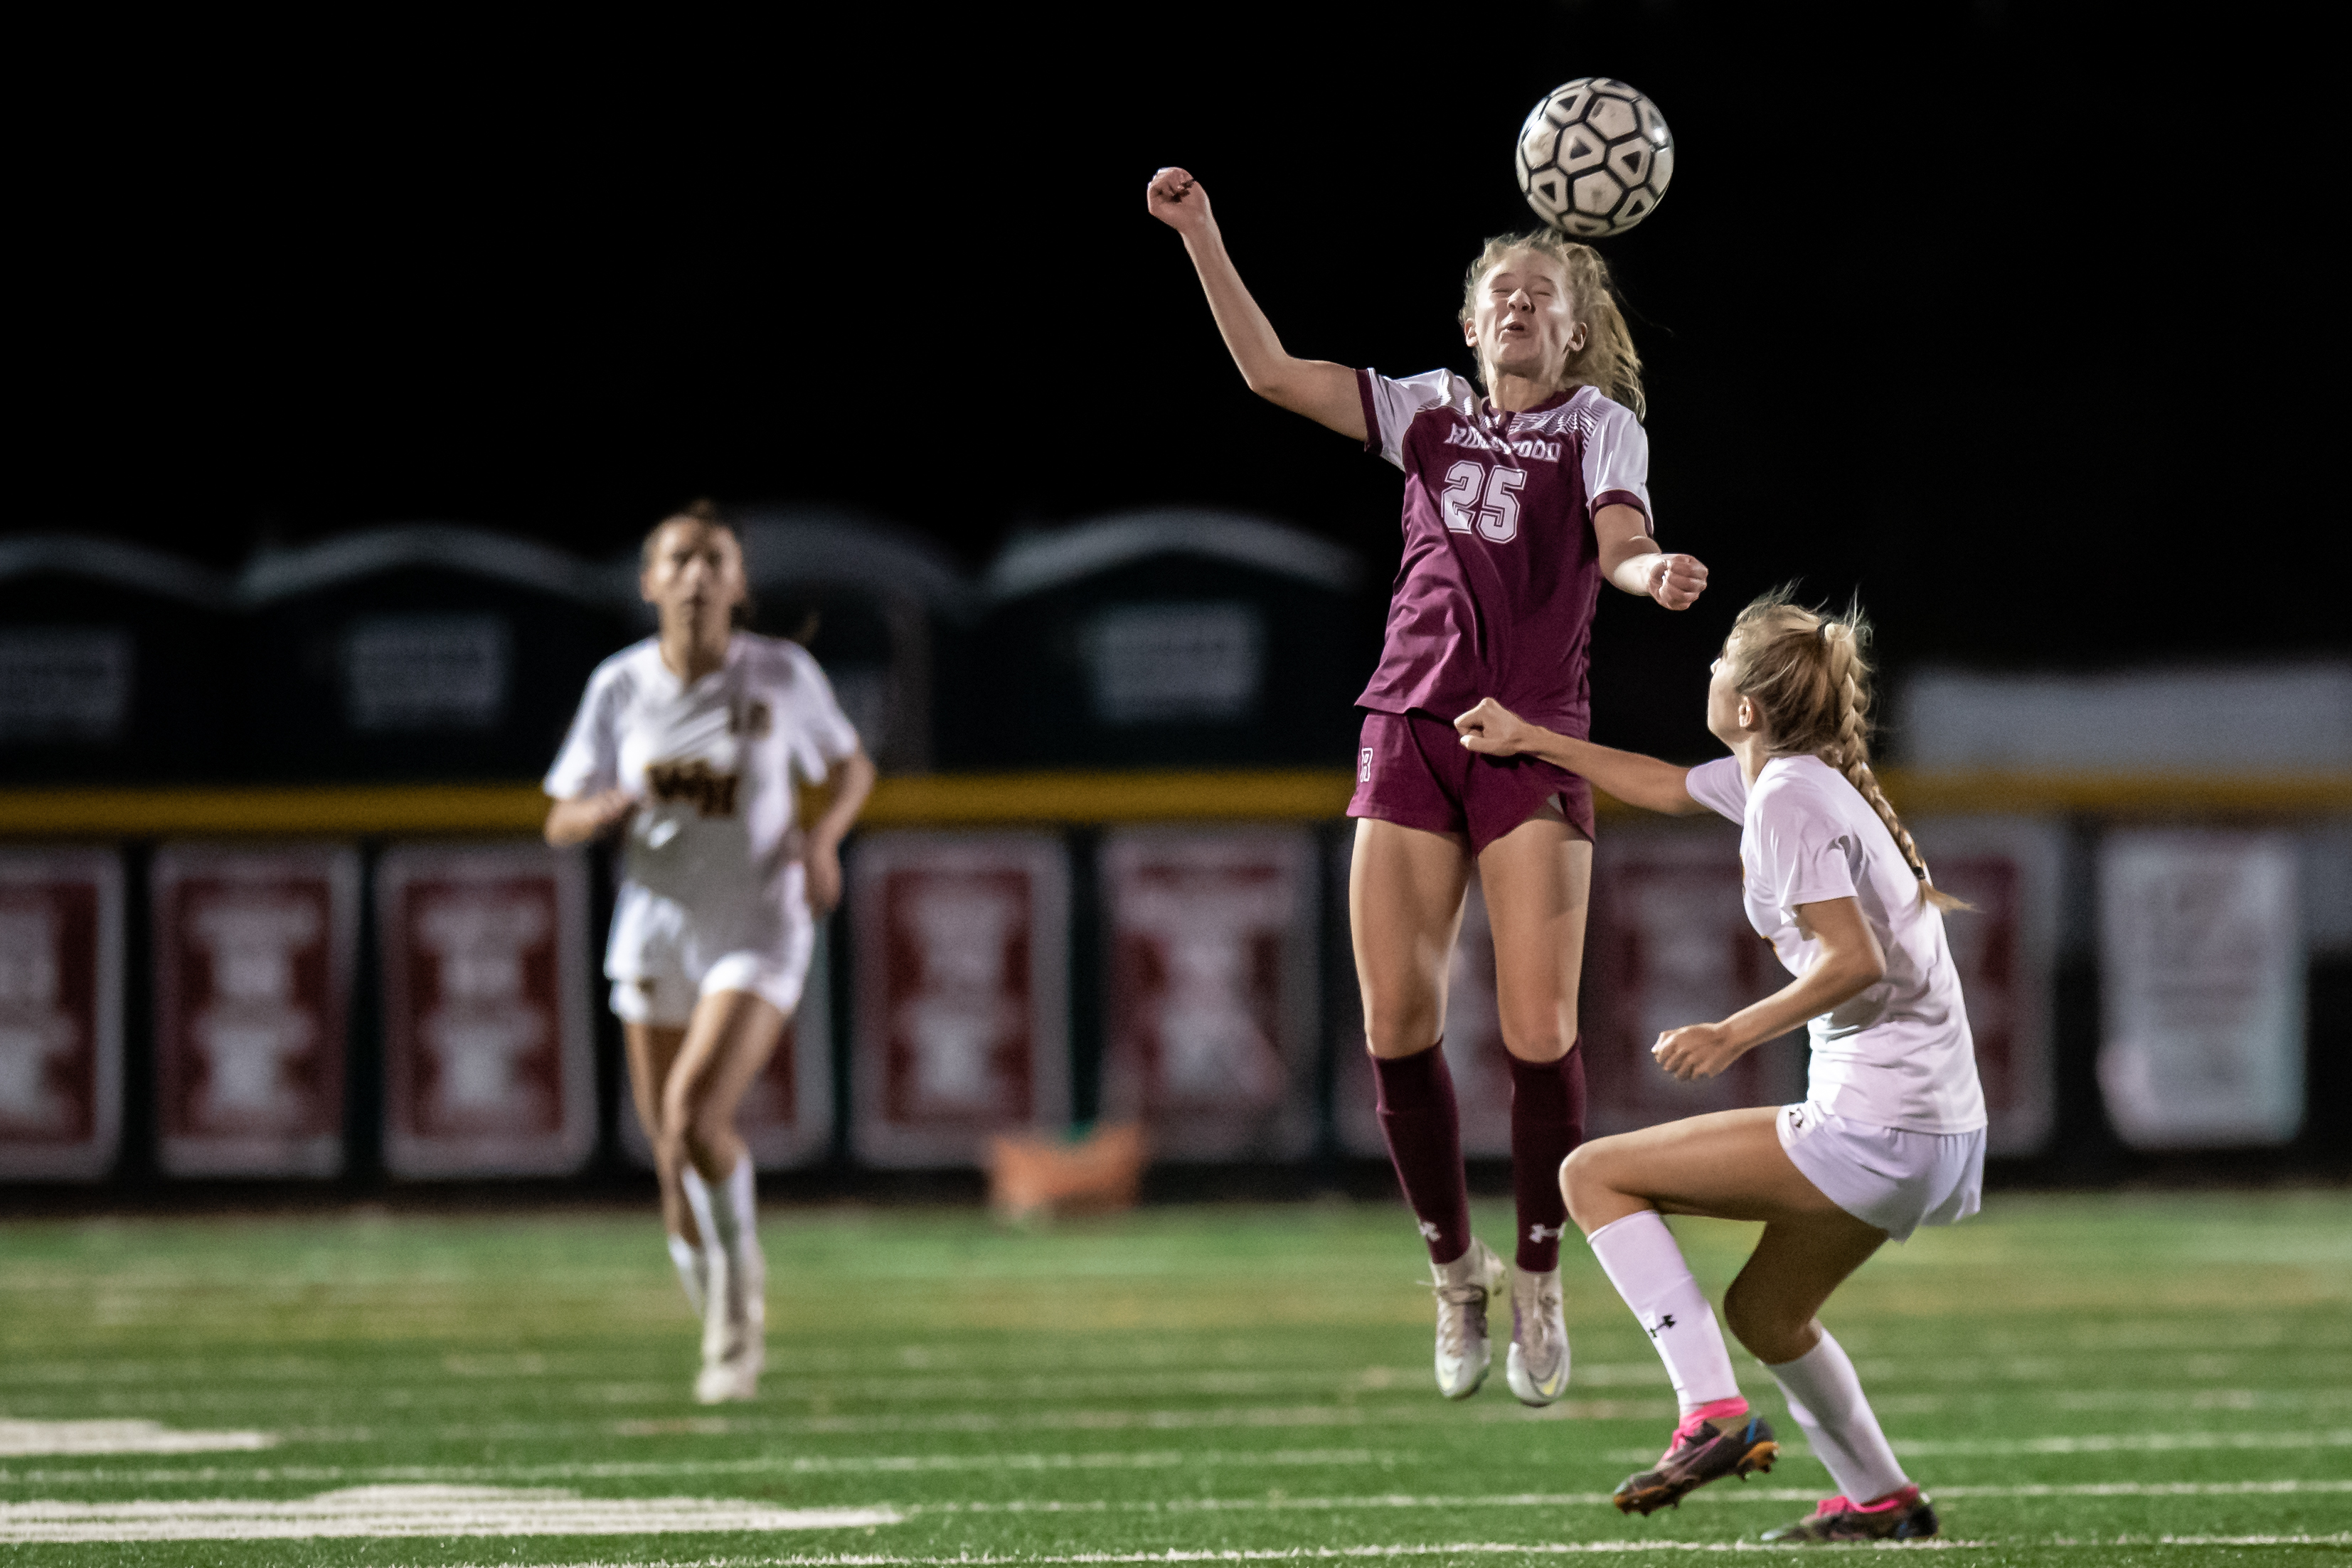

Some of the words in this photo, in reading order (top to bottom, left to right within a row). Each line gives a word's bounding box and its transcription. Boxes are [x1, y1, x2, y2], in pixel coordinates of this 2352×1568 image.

[1443, 422, 1563, 462] RIDOOD
[1441, 460, 1527, 544] 25
[1360, 747, 1373, 783] R
